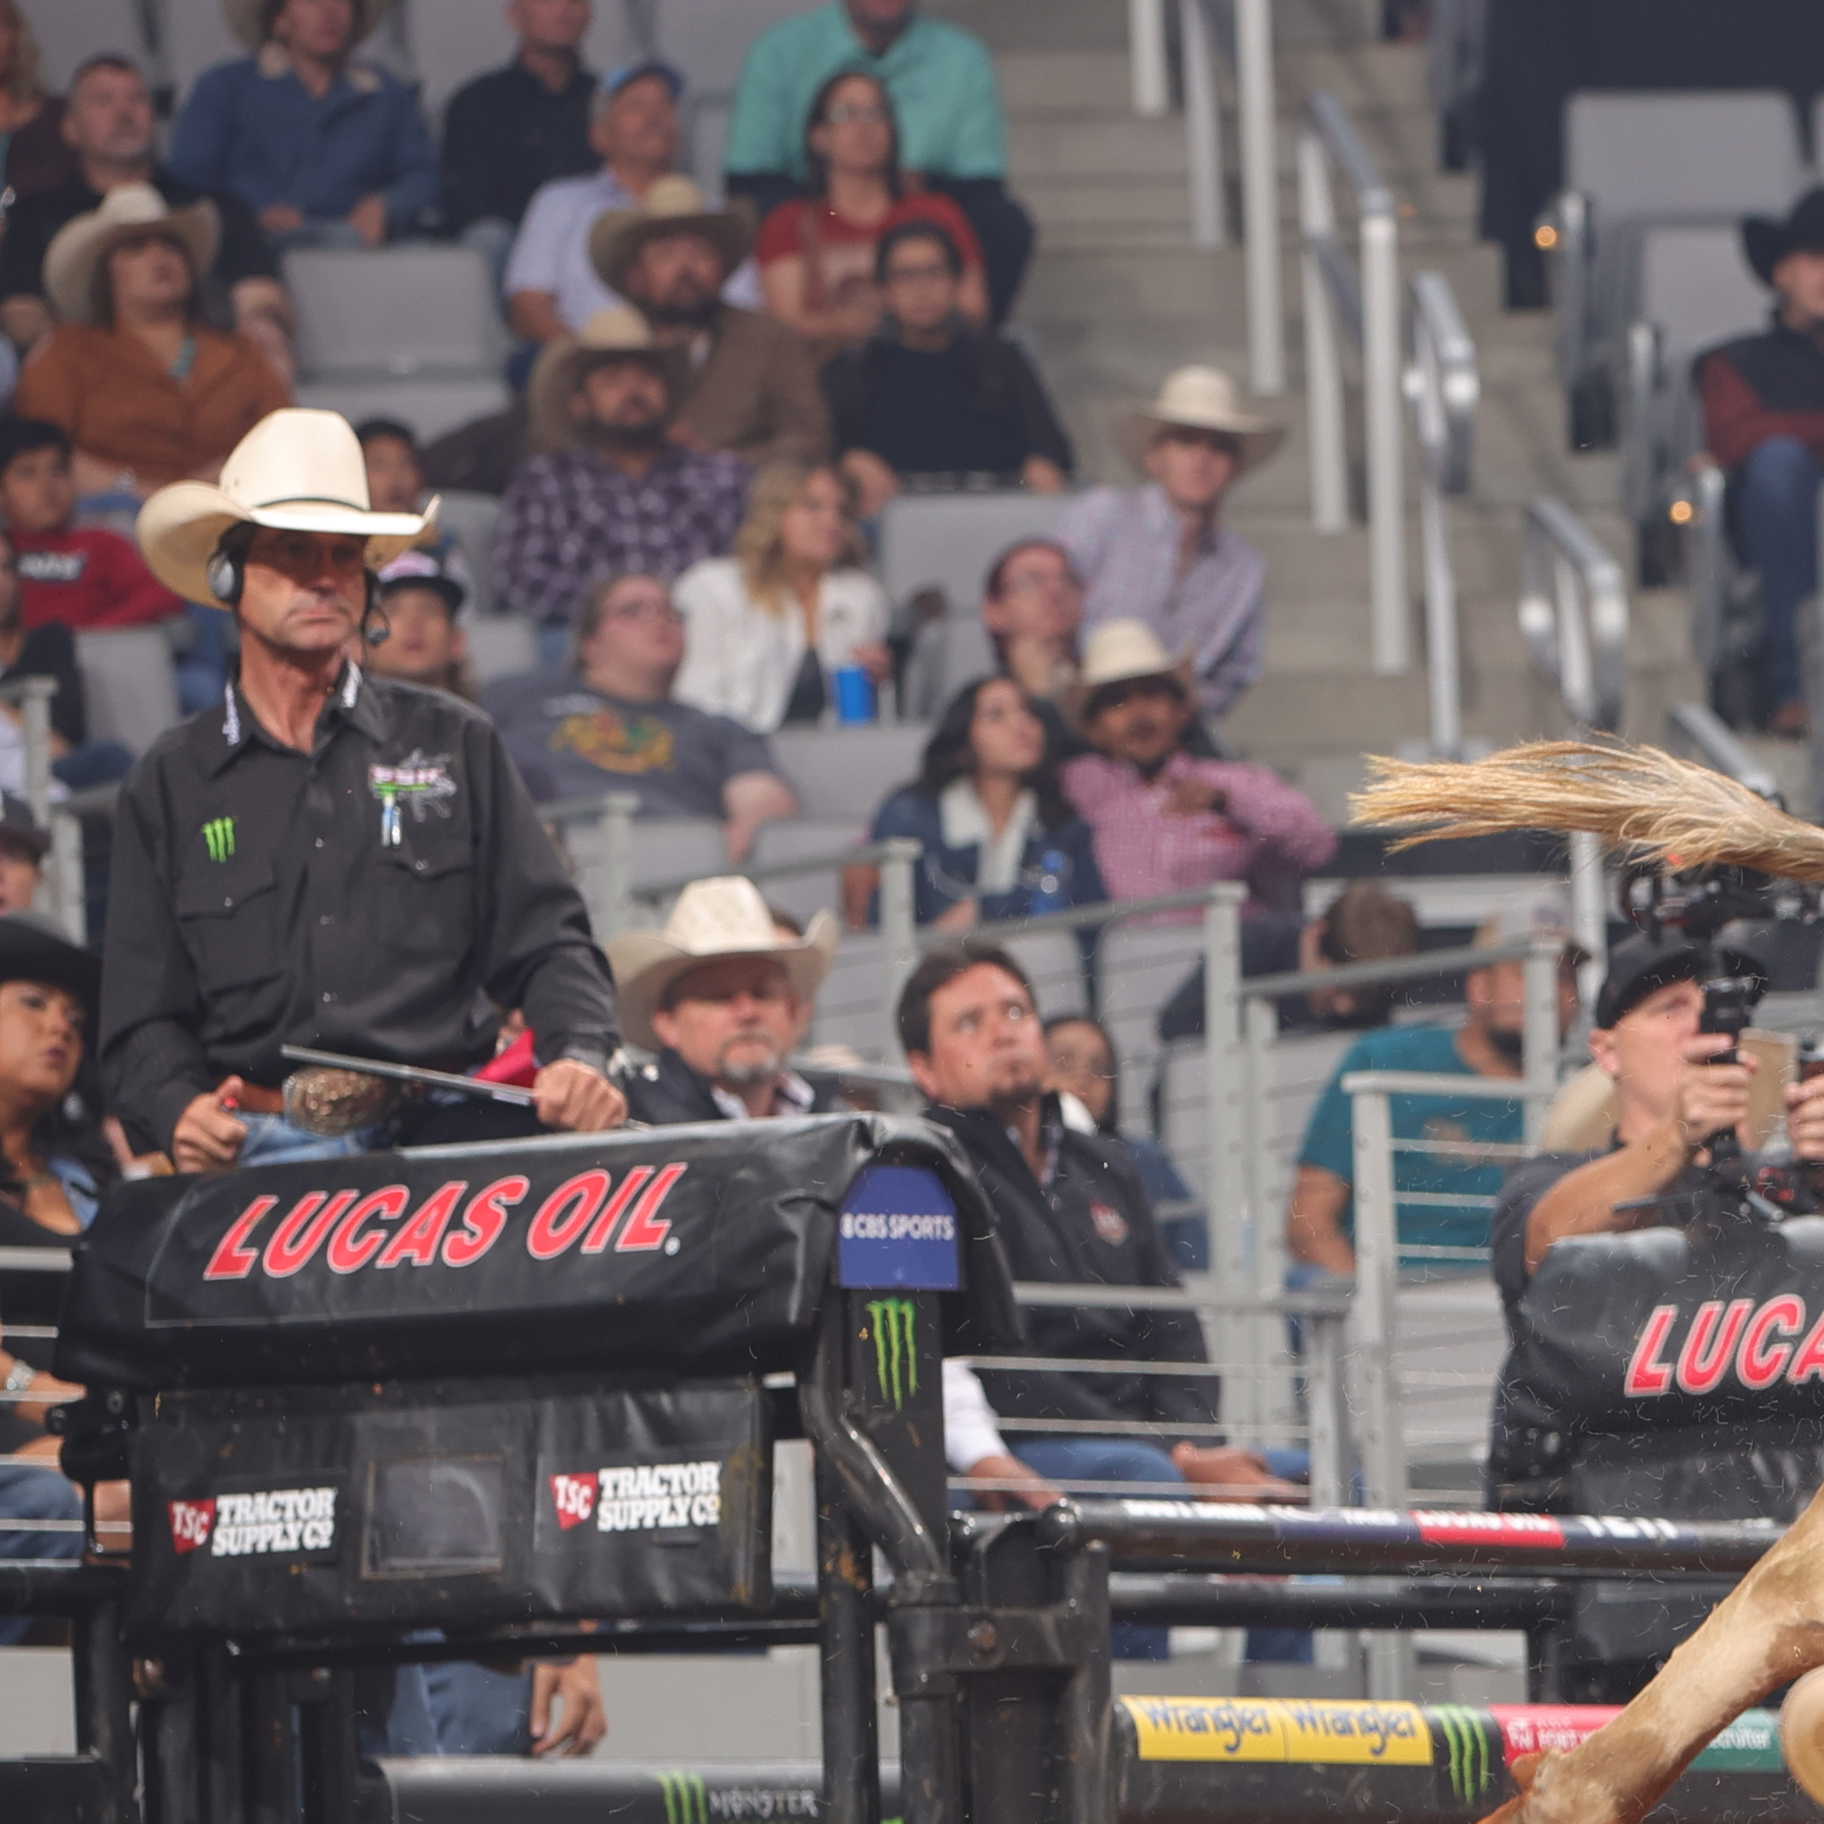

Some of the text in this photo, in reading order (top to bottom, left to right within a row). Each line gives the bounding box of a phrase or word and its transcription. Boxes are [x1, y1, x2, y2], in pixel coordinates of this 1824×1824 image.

[203, 1162, 688, 1281] LUCAS OIL
[888, 1214, 955, 1240] SPORTS
[554, 1476, 593, 1521] TSC
[599, 1462, 721, 1497] TRACTOR
[172, 1502, 209, 1546] TSC
[216, 1488, 335, 1524] TRACTOR
[597, 1495, 687, 1532] SUPPLY
[211, 1521, 302, 1557] SUPPLY
[1147, 1701, 1272, 1755] Wrangler
[1292, 1702, 1418, 1757] Wrangler
